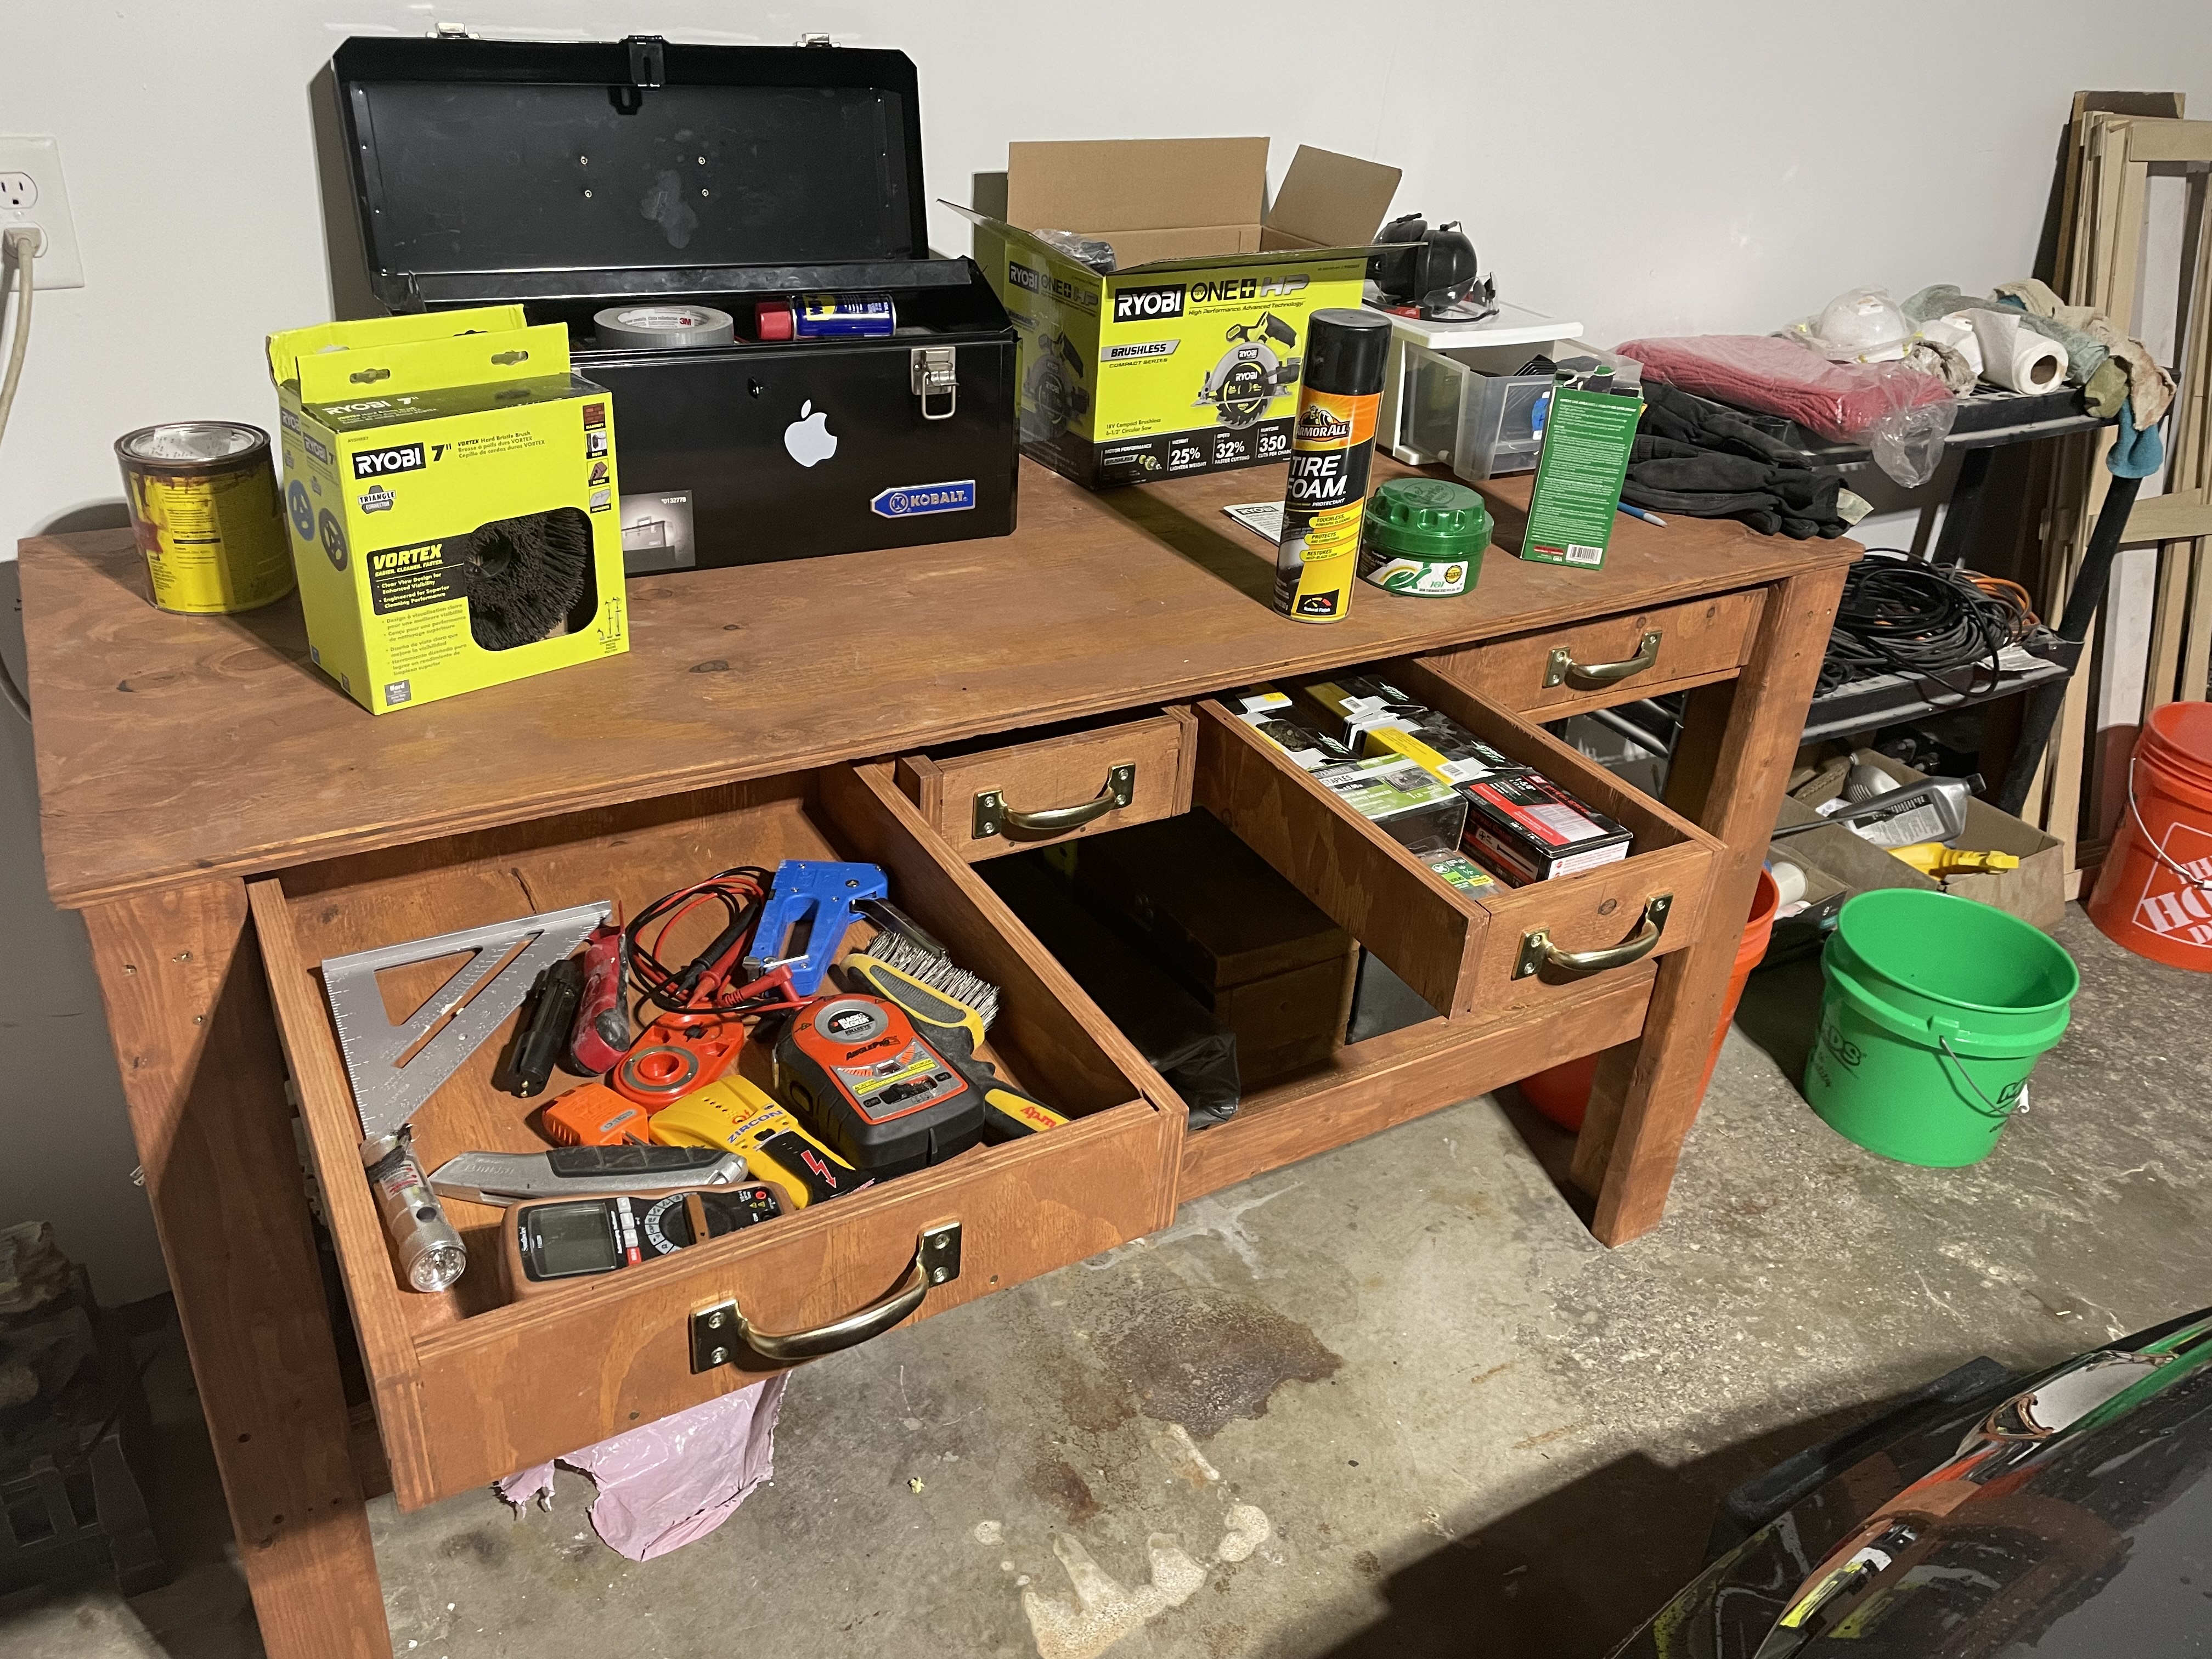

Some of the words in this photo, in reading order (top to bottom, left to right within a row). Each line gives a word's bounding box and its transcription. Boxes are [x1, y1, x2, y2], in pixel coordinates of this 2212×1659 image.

[1011, 265, 1037, 289] RYOBI
[1117, 290, 1181, 318] RYOBI
[1260, 274, 1310, 297] HP
[1188, 307, 1203, 315] High
[1242, 302, 1271, 312] Advanced
[679, 318, 692, 326] 3M
[1111, 343, 1167, 358] BRUSHLESS
[1239, 349, 1257, 358] RYOBI
[1235, 371, 1258, 381] RYOBI
[322, 400, 392, 415] RYOBI
[458, 438, 479, 447] VORTEX
[523, 439, 545, 448] VORTEX
[1216, 441, 1245, 459] 32%
[1259, 435, 1286, 452] 350
[356, 447, 421, 475] RYOBI
[431, 443, 452, 462] 7"
[1170, 447, 1200, 466] 25%
[1292, 455, 1341, 477] TIRE
[359, 490, 395, 503] TRIANGLE
[910, 490, 965, 507] KOBALT
[1312, 498, 1346, 507] PROTECTANT
[373, 544, 442, 571] VORTEX
[413, 575, 432, 584] Design
[382, 585, 410, 595] Enhanced
[411, 580, 436, 589] Visibility
[383, 592, 416, 603] Engineered
[426, 585, 450, 594] Superior
[411, 592, 446, 603] Performance
[1322, 775, 1353, 786] STAPLES
[840, 1018, 870, 1029] DECKER
[727, 1110, 783, 1143] ZIRCON
